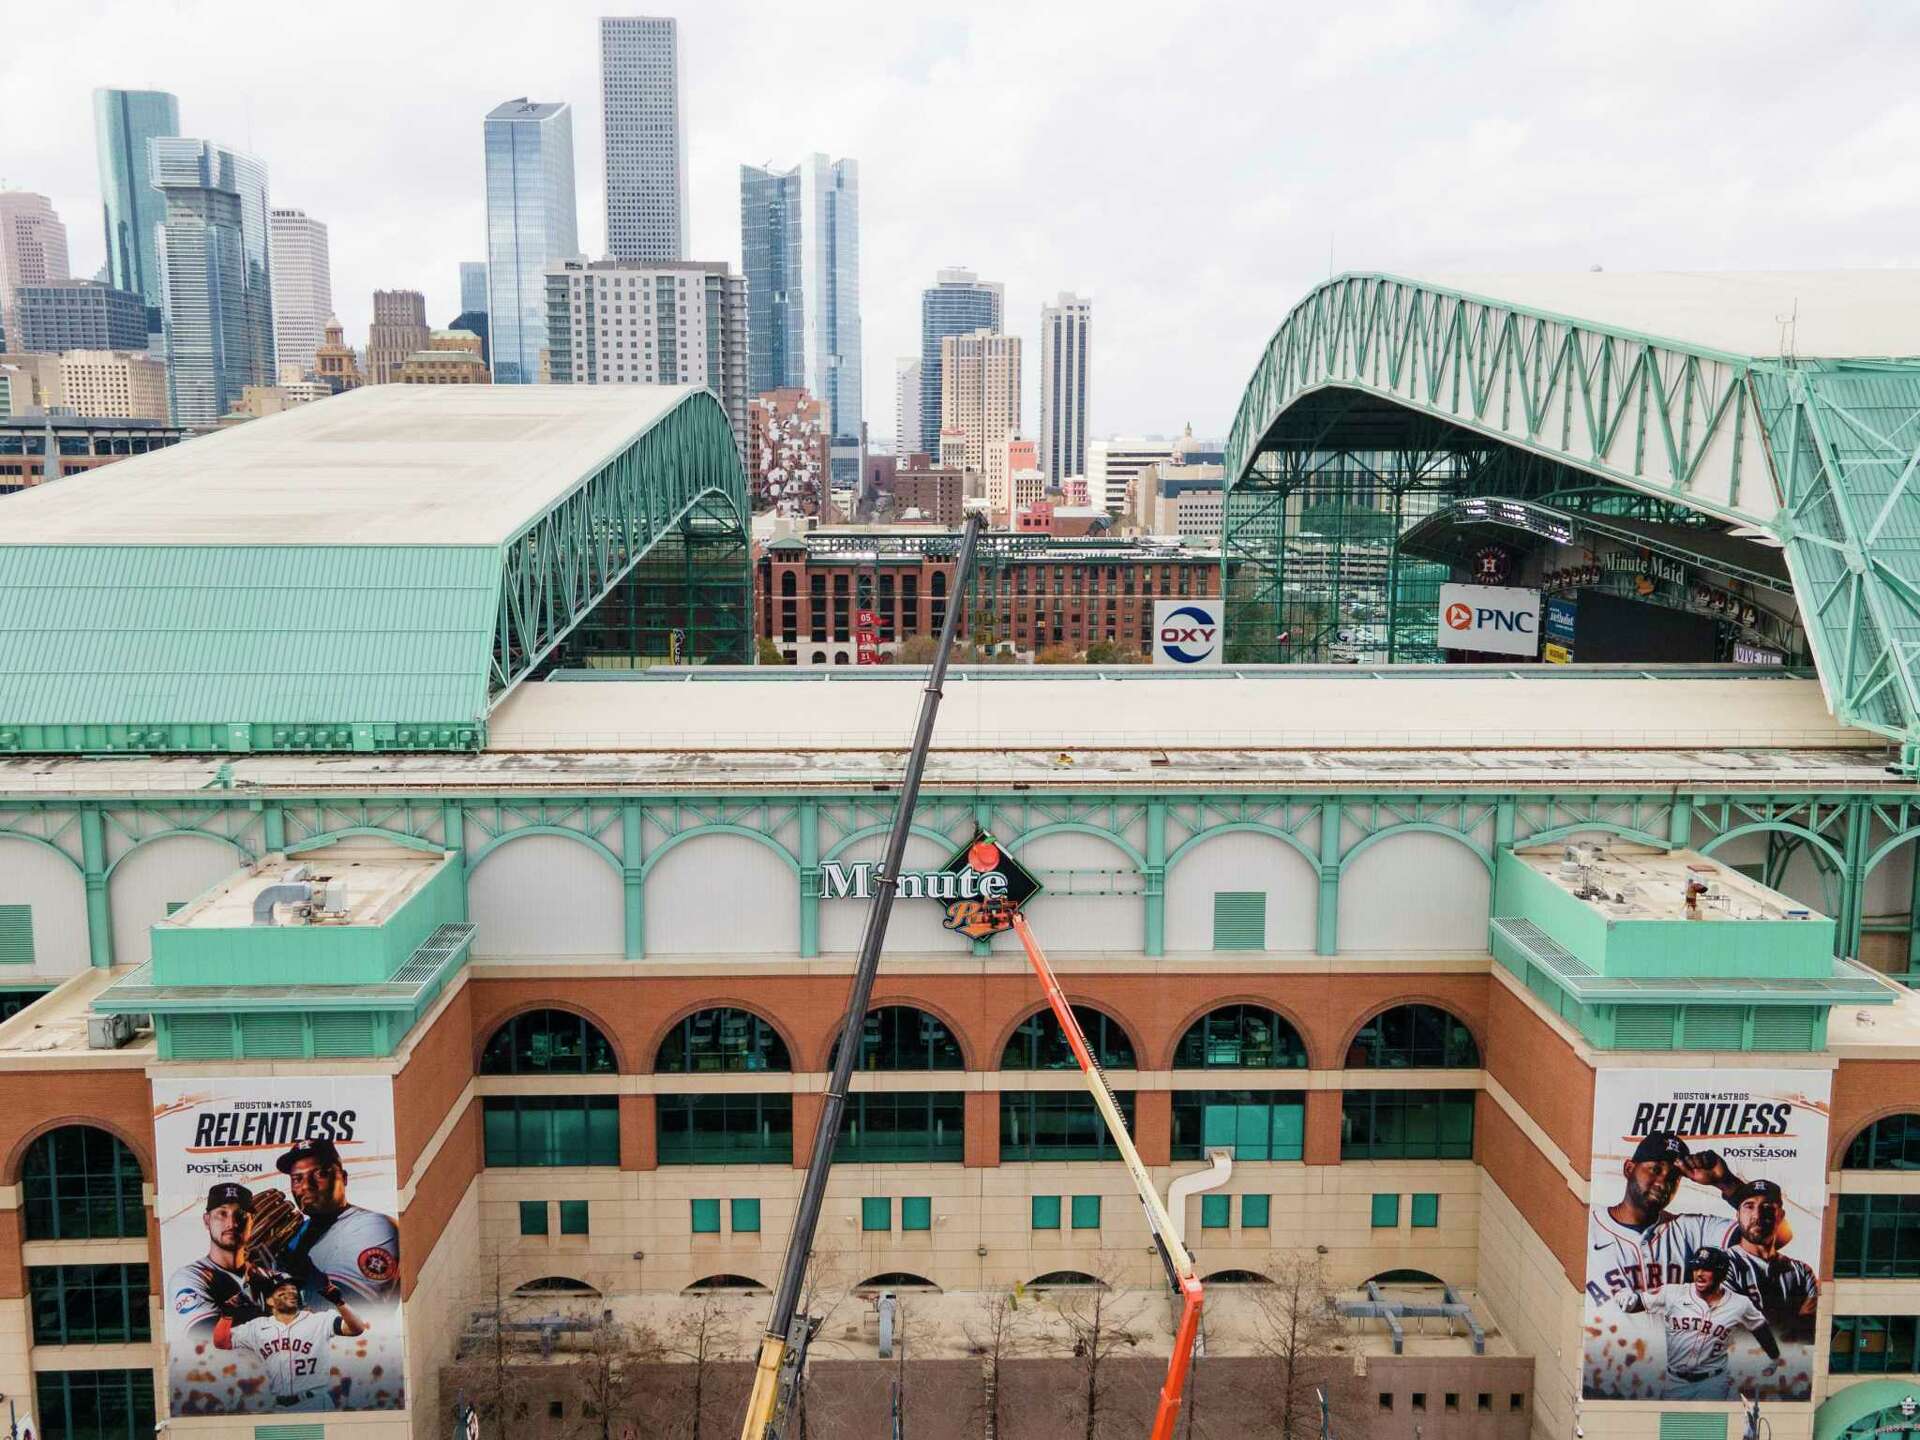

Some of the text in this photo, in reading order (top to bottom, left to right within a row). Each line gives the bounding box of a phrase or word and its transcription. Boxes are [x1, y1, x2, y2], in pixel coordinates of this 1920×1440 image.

[1604, 552, 1684, 586] Minute Maid
[1475, 607, 1534, 634] PNC
[1161, 628, 1217, 643] OXY
[234, 1100, 313, 1110] HOUSTON ASTROS
[1673, 1092, 1750, 1101] HOUSTON ASTROS
[194, 1110, 357, 1148] RELENTLESS
[1631, 1102, 1792, 1137] RELENTLESS
[1723, 1147, 1797, 1158] POSTSEASON
[186, 1163, 263, 1174] POSTSEASON
[1672, 1316, 1729, 1342] ASTROS
[259, 1337, 313, 1360] ASTROS
[294, 1357, 318, 1376] 27
